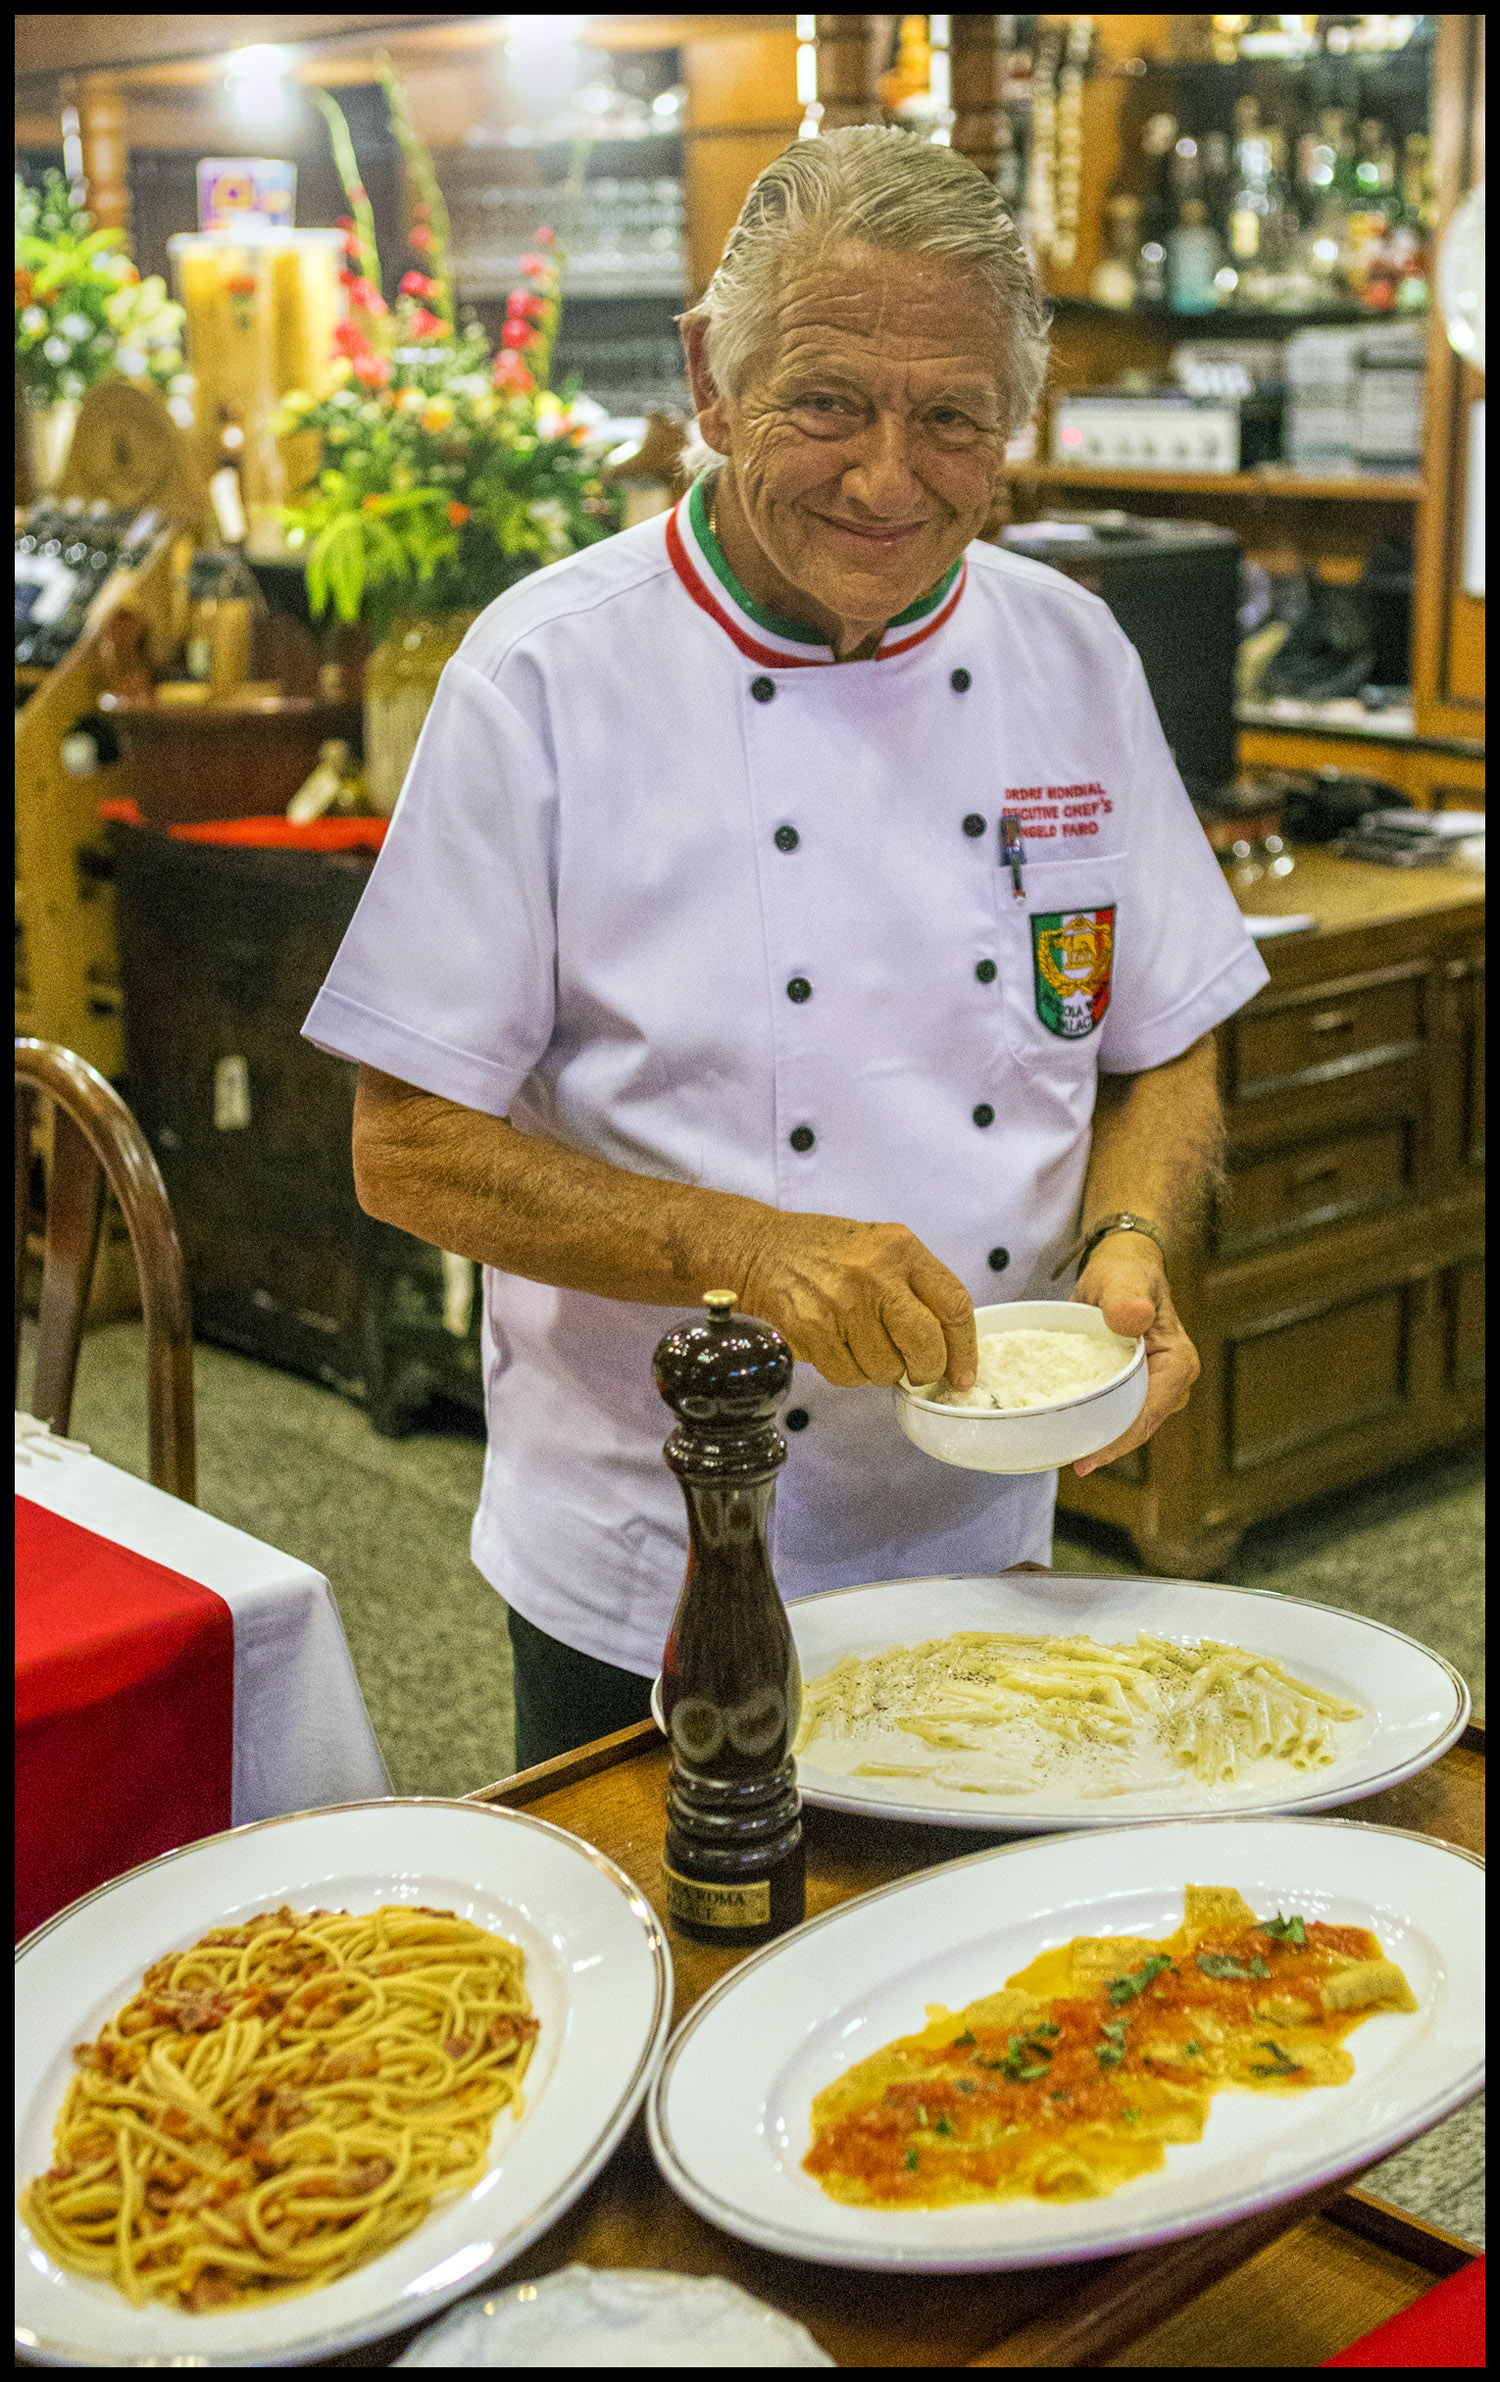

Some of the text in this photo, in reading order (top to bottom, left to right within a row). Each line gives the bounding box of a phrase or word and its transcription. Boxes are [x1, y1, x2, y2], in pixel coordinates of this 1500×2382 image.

[1047, 783, 1107, 799] MONDIAL
[1063, 797, 1113, 818] CHEF'S
[1020, 821, 1098, 838] NGELO FARO
